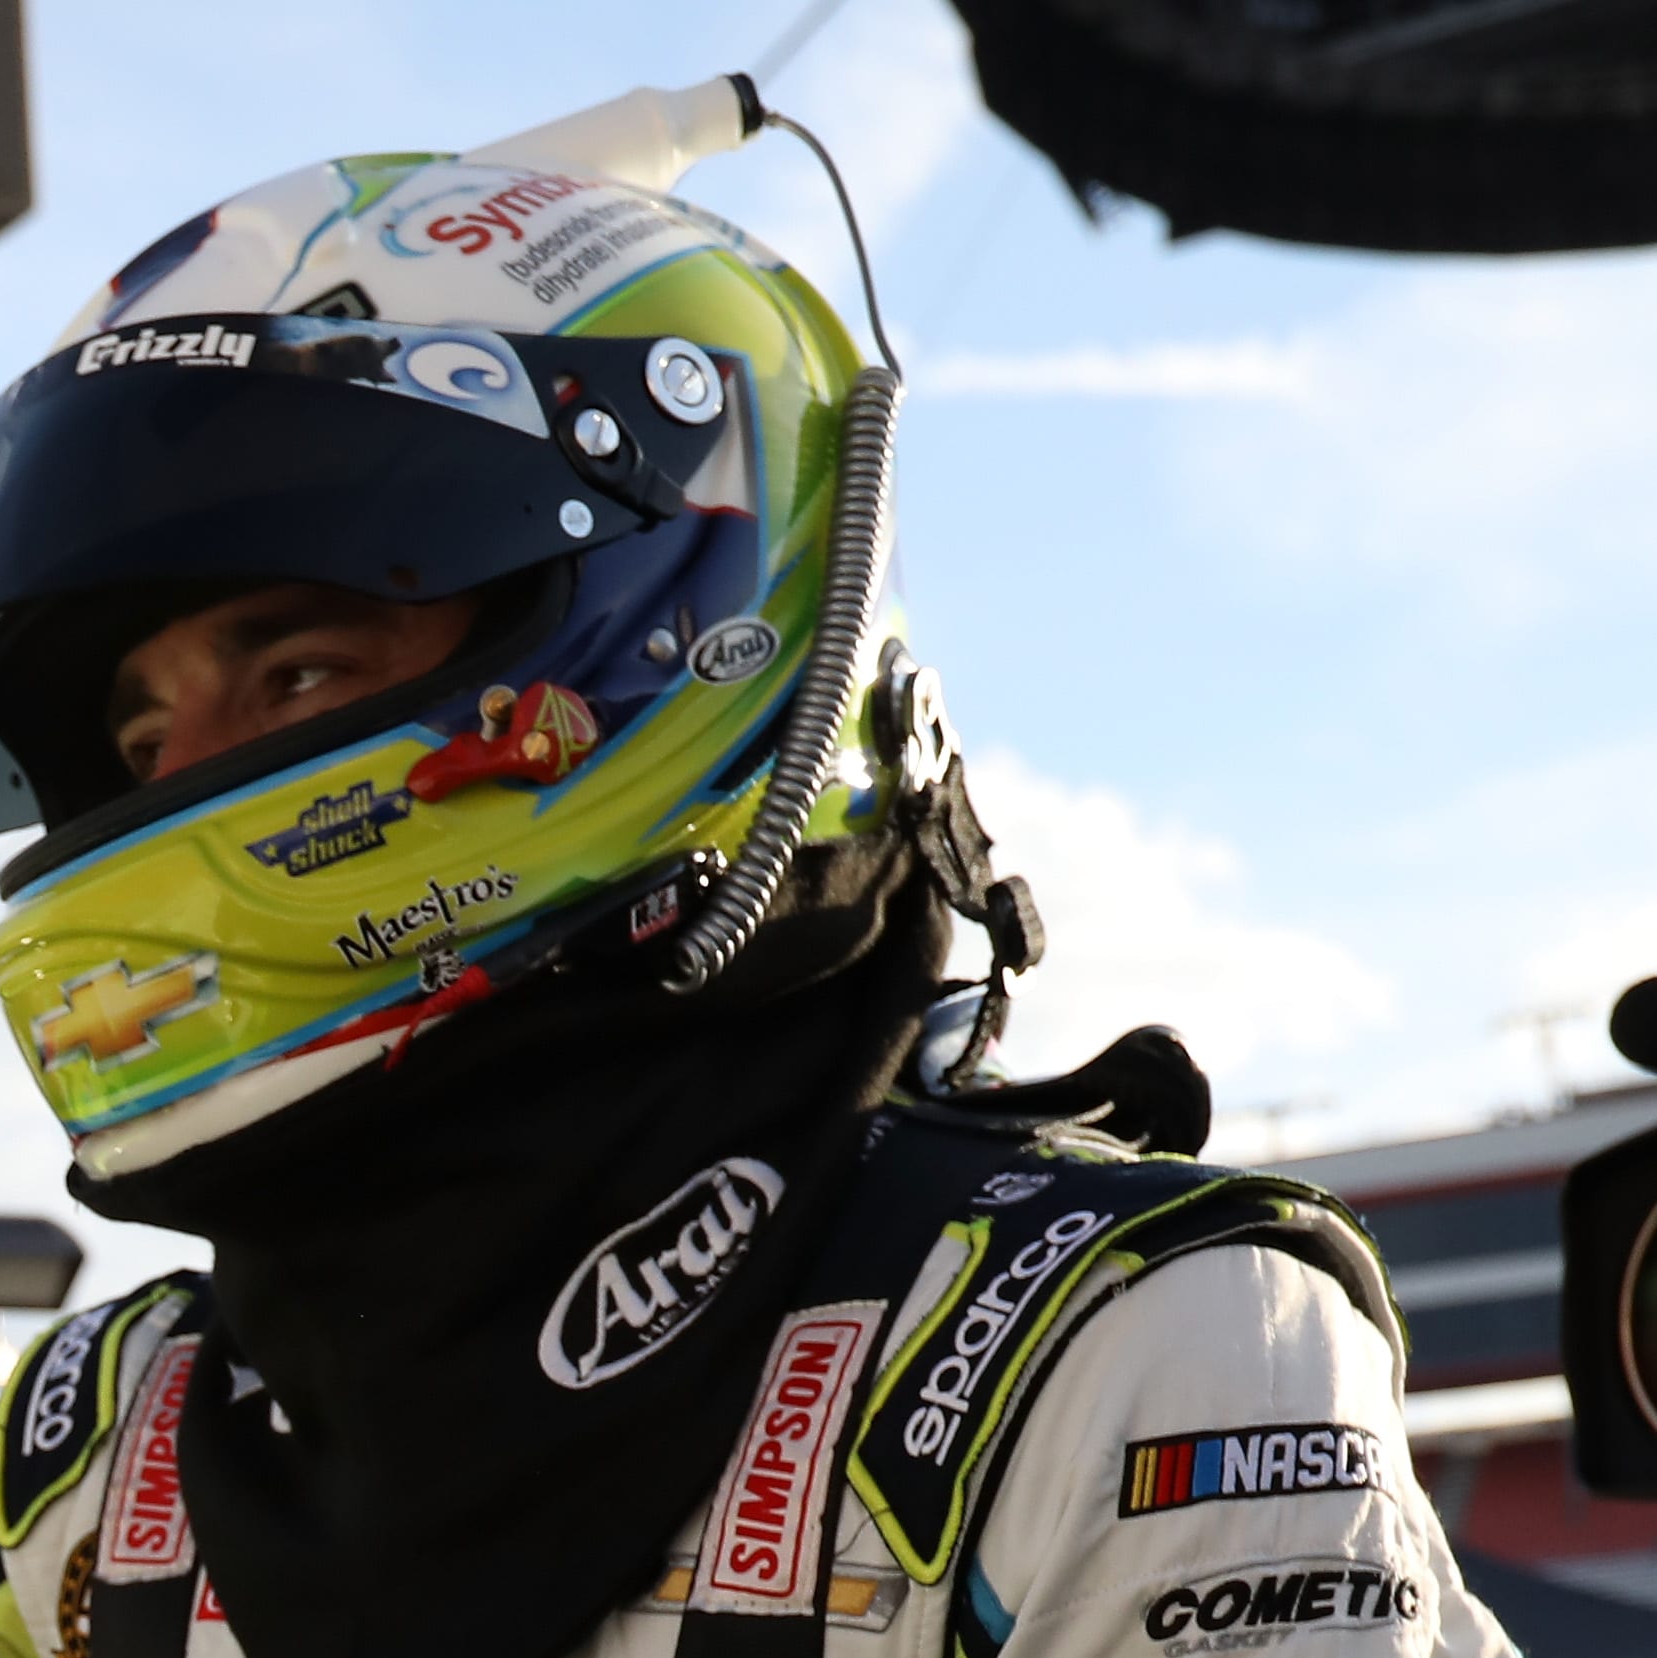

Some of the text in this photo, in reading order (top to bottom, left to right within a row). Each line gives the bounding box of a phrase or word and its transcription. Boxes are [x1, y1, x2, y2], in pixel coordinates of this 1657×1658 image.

[75, 324, 257, 376] Grizzly
[334, 864, 518, 969] Maestro's
[903, 1210, 1115, 1467] sparco
[729, 1339, 839, 1582] SIMPSON
[1221, 1430, 1389, 1495] NASCA
[1145, 1570, 1420, 1641] COMETIC
